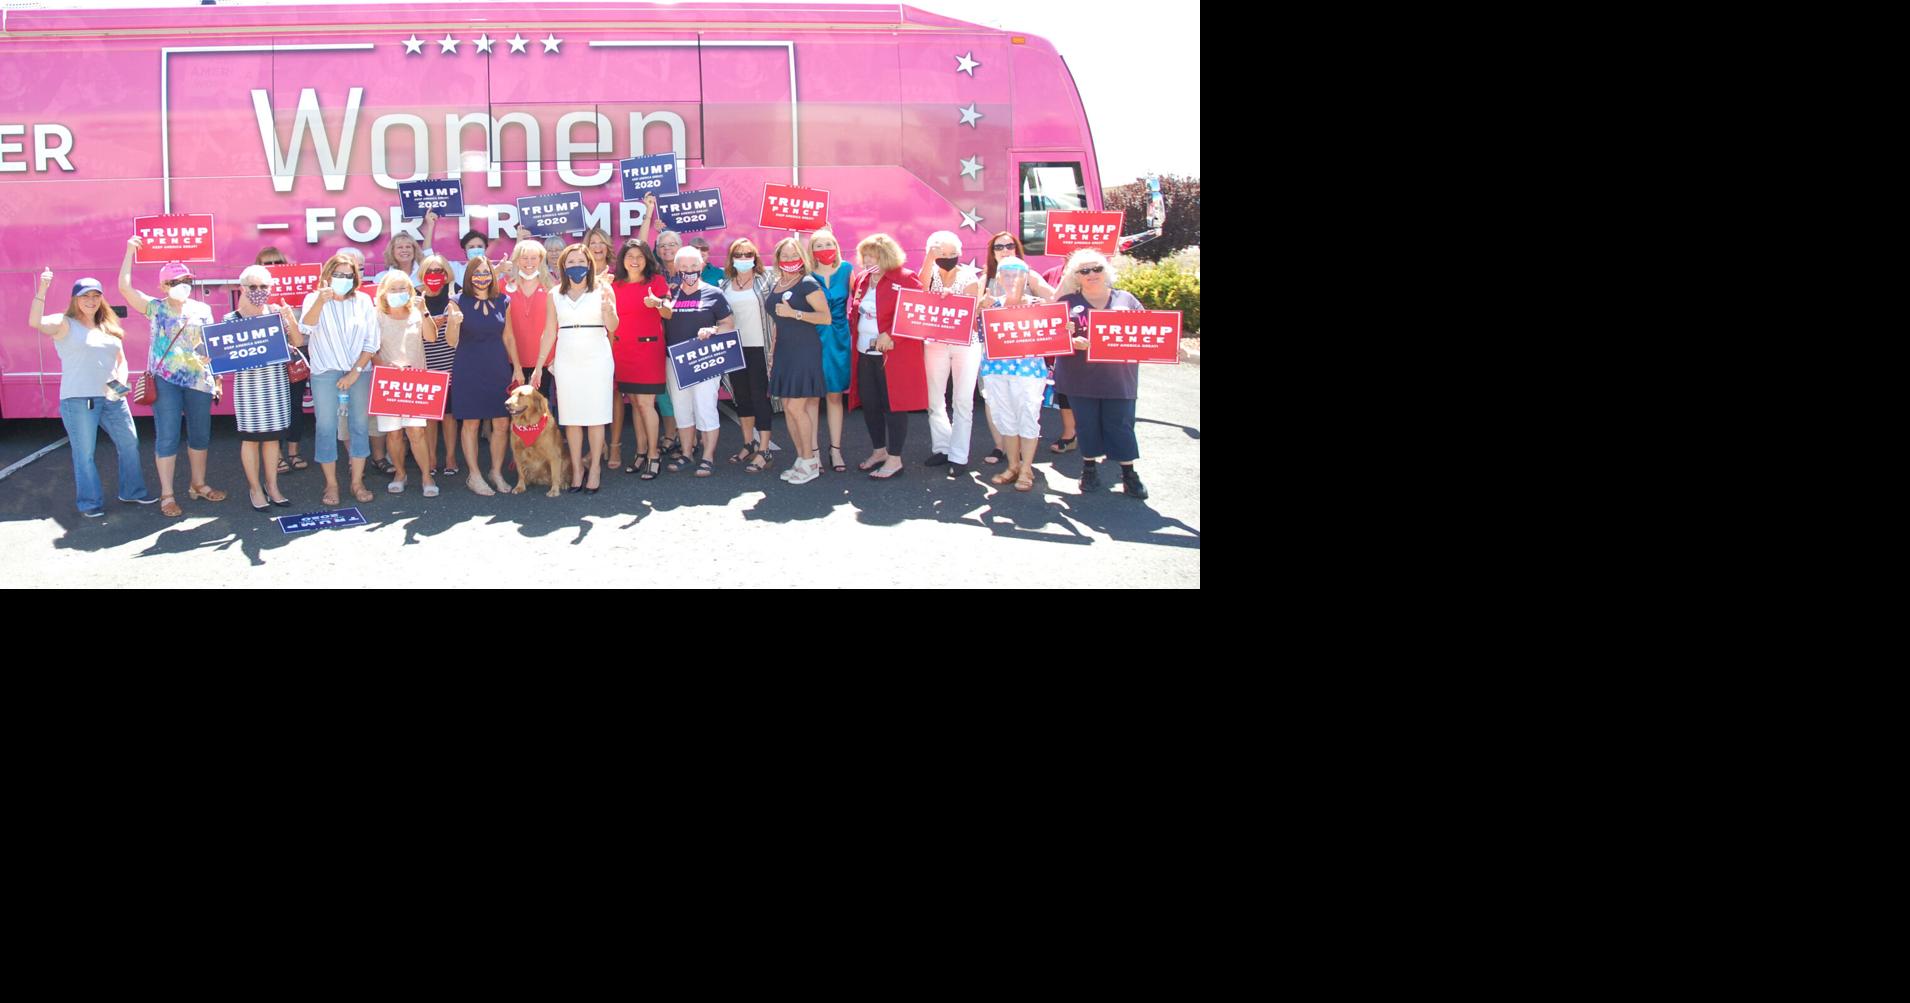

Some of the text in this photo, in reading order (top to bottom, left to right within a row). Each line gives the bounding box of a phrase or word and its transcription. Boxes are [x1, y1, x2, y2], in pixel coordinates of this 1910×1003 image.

[250, 87, 687, 191] Women
[0, 124, 76, 171] ER
[623, 163, 673, 178] TRUMP
[634, 179, 661, 190] 2020
[402, 187, 459, 198] TRUMP
[417, 200, 447, 209] 2020
[521, 201, 579, 216] TRUMP
[659, 198, 718, 214] TRUMP
[768, 196, 825, 210] TRUMP
[771, 206, 819, 217] PENCE
[458, 202, 646, 239] TRMP
[536, 216, 568, 226] 2020
[675, 213, 707, 225] 2020
[140, 227, 208, 238] TRUMP
[1053, 223, 1116, 234] TRUMP
[147, 237, 203, 245] PENCE
[1058, 233, 1110, 241] PENCE
[271, 275, 317, 286] RUMP
[903, 302, 969, 319] TRUMP
[907, 313, 962, 326] PENCE
[990, 317, 1062, 333] TRUMP
[209, 326, 279, 347] TRUMP
[997, 328, 1057, 340] PENCE
[1095, 324, 1173, 337] TRUMP
[1102, 335, 1165, 344] PENCE
[230, 346, 267, 360] 2020
[675, 339, 737, 364] TRUMP
[693, 356, 725, 373] 2020
[378, 380, 442, 393] TRUMP
[382, 391, 435, 401] PENCE
